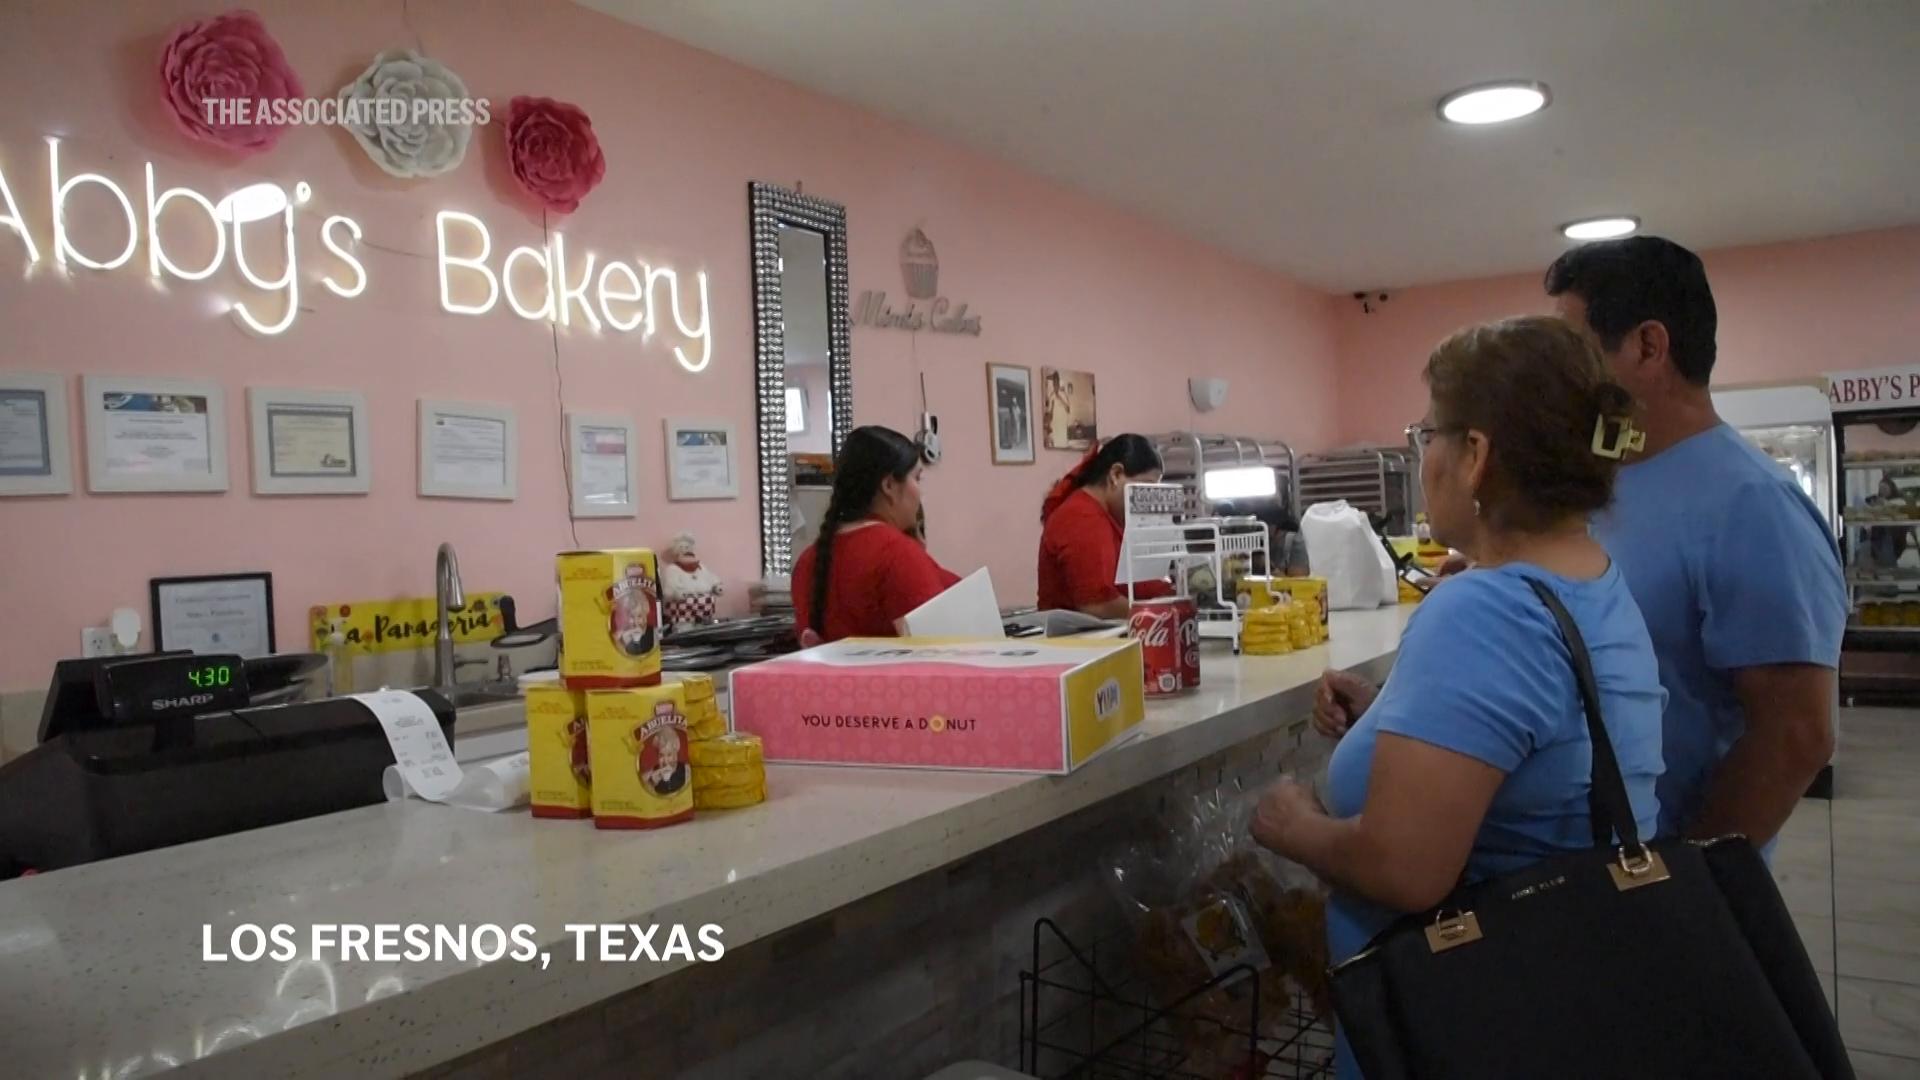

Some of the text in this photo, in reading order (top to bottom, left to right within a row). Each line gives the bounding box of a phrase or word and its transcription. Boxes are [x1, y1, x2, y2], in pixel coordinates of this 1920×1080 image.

[435, 209, 711, 373] Bakery
[1829, 374, 1903, 404] ABBY'S
[151, 693, 214, 711] SHARP
[802, 714, 977, 732] YOU DESERVE A DONUT
